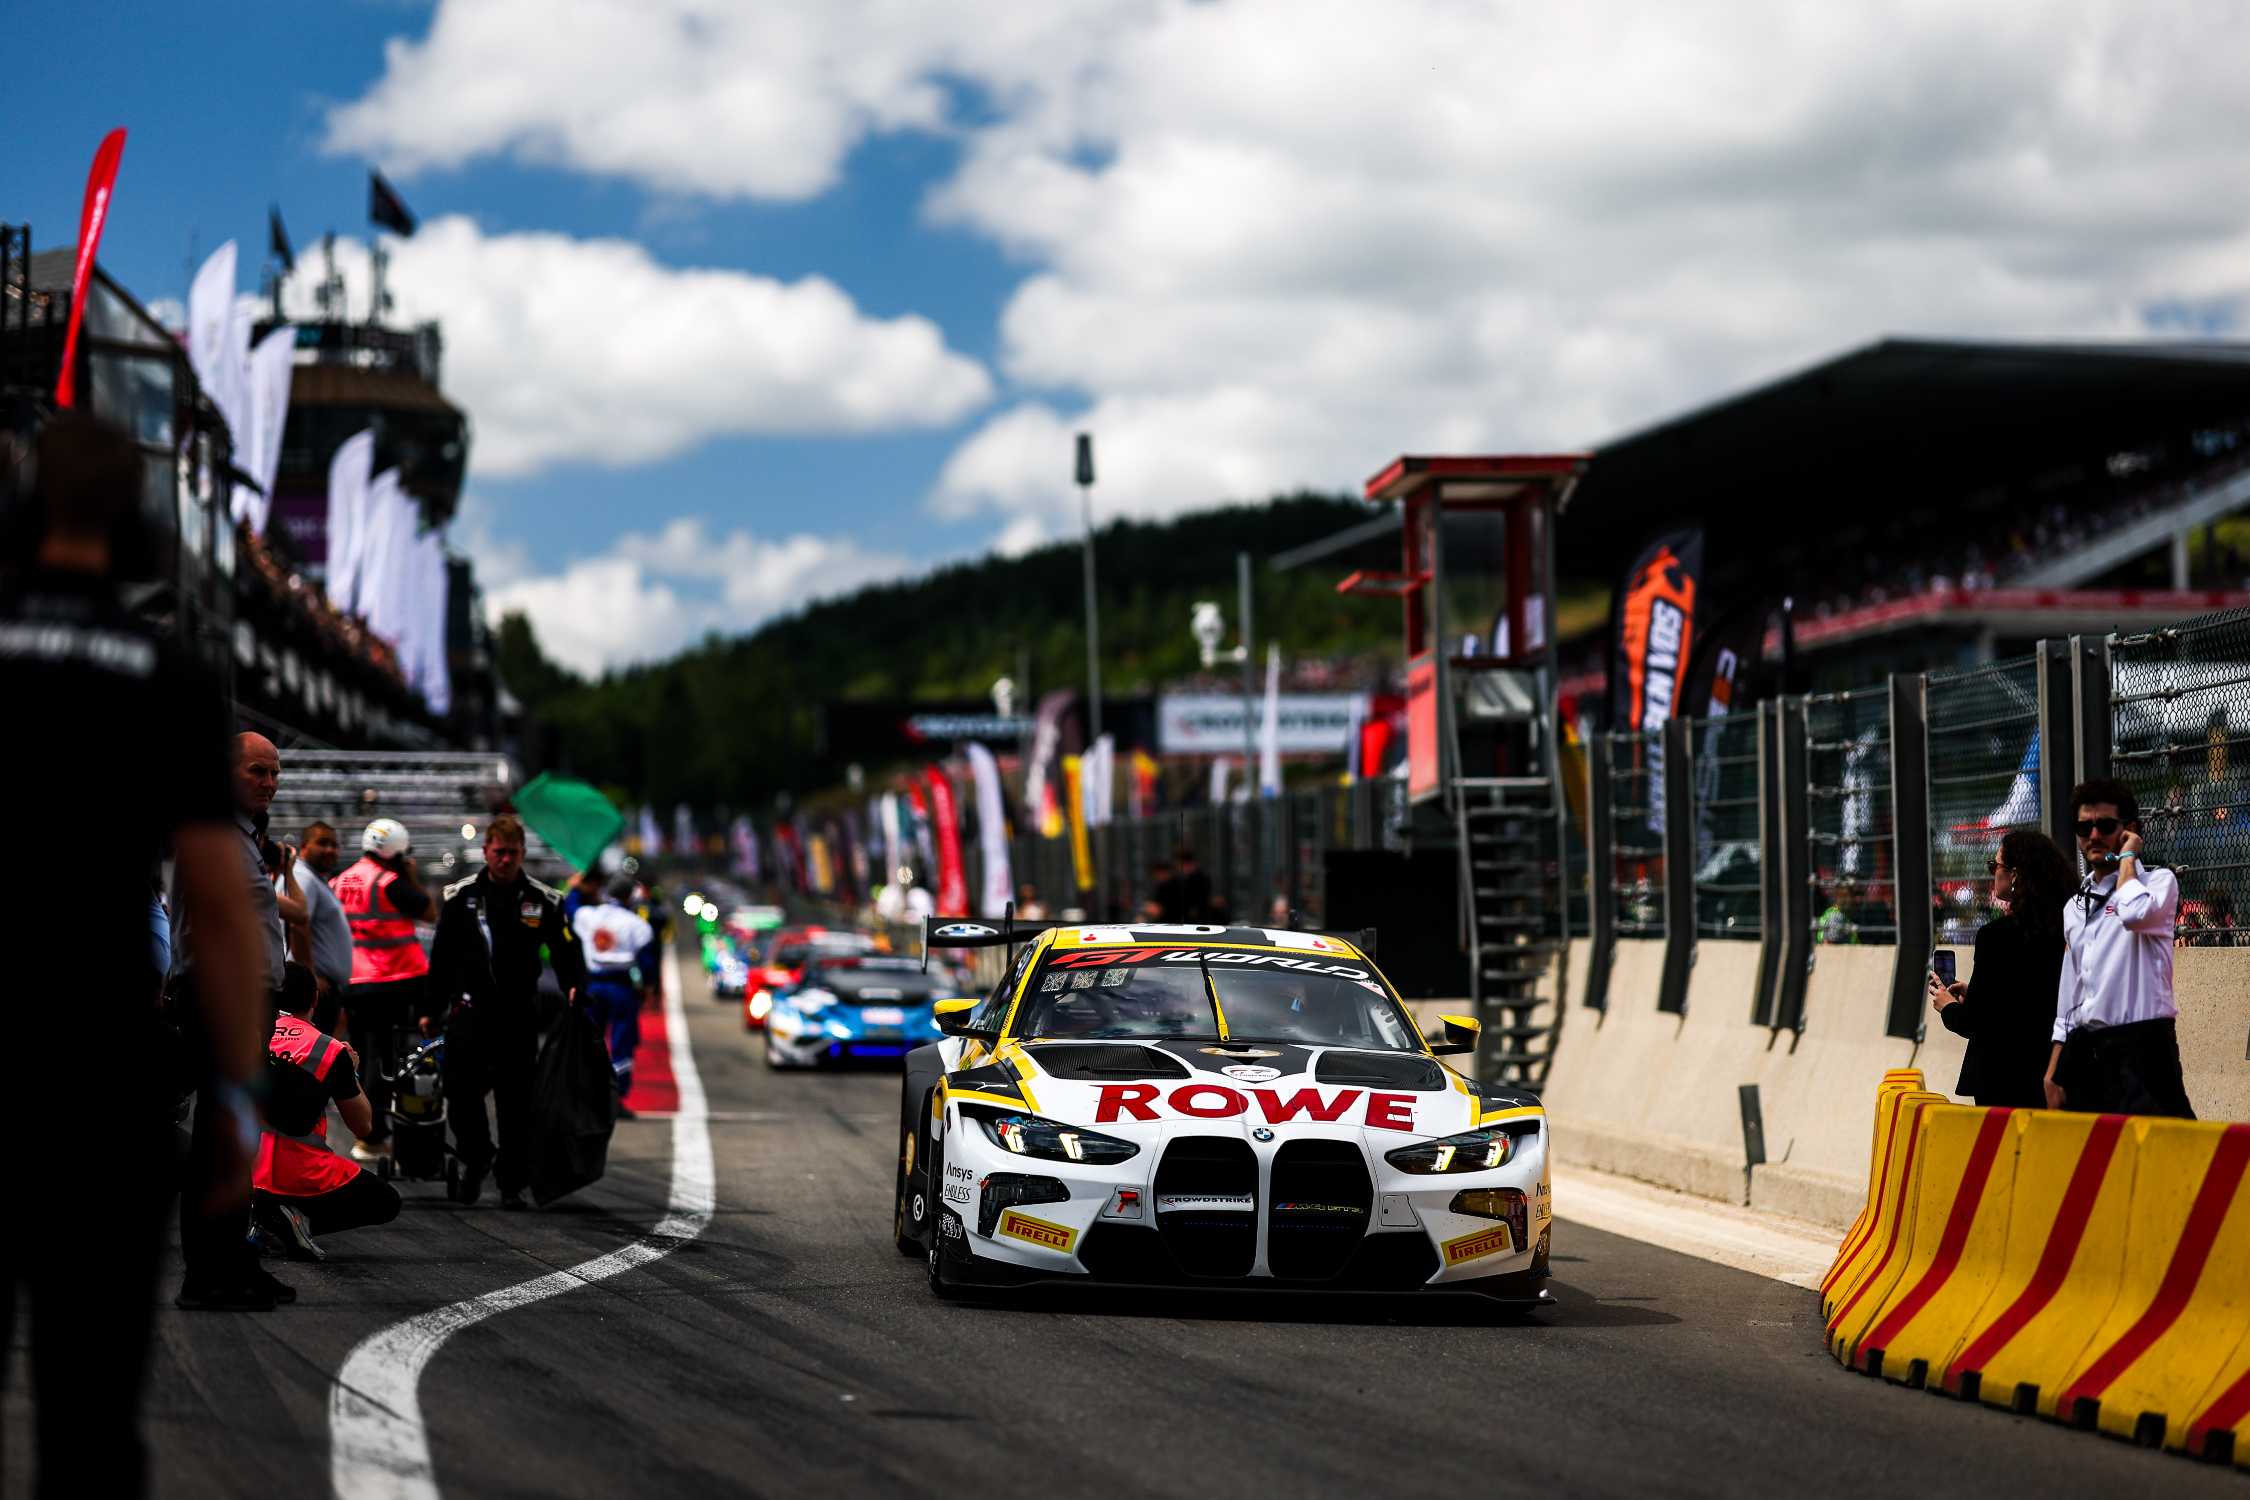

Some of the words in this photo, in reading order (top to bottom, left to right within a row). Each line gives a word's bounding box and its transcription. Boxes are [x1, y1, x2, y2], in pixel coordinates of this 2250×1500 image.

[1050, 948, 1201, 968] GT
[1160, 952, 1368, 979] WORLD
[1096, 1083, 1416, 1131] ROWE
[946, 1161, 974, 1182] Ansys
[944, 1184, 971, 1203] ENDLESS
[1164, 1196, 1252, 1204] CROWDSTRIKE
[1007, 1216, 1070, 1247] PIRELLI
[1448, 1231, 1503, 1260] PIRELLI
